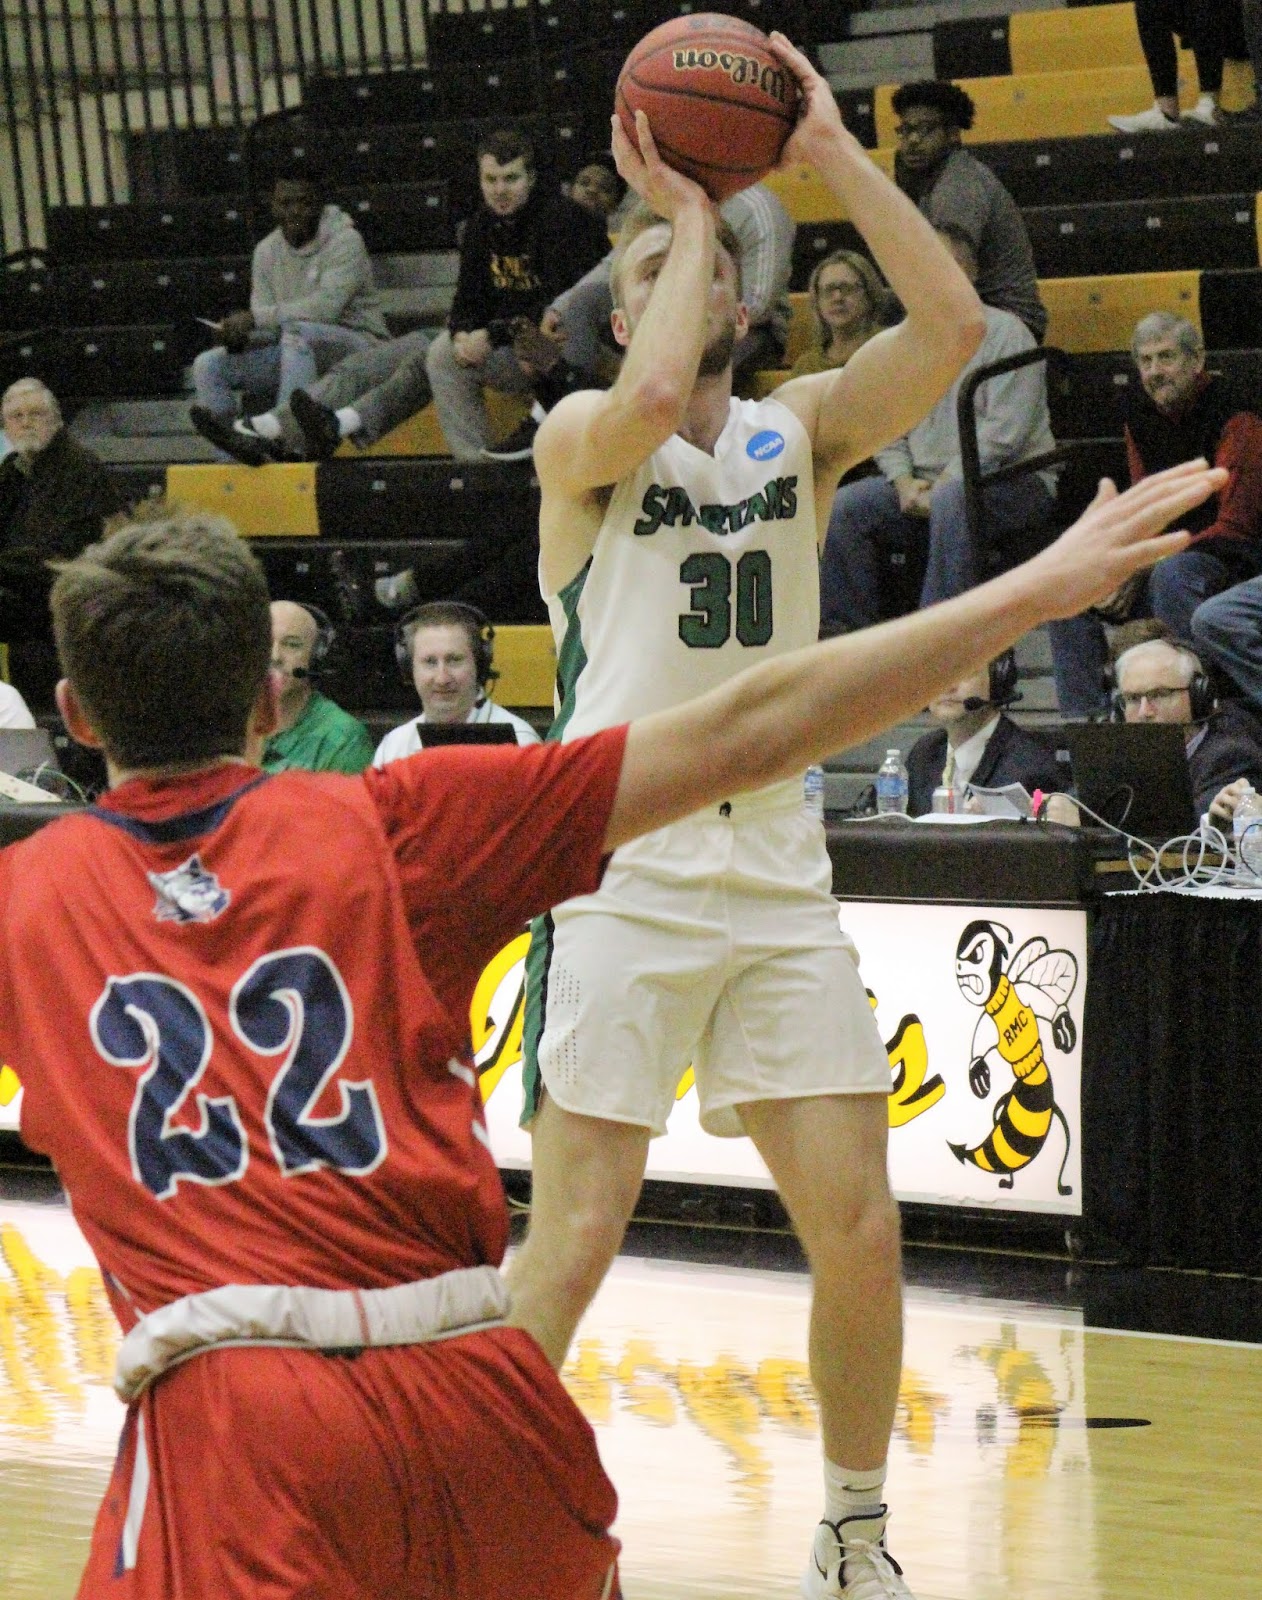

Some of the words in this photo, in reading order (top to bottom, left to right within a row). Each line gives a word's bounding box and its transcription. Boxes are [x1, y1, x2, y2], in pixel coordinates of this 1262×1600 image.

[673, 49, 788, 104] Wilson
[753, 437, 784, 458] NCAA
[633, 475, 798, 536] SPARTANS
[678, 550, 773, 649] 30
[1003, 1009, 1028, 1047] RMC
[89, 945, 389, 1201] 22
